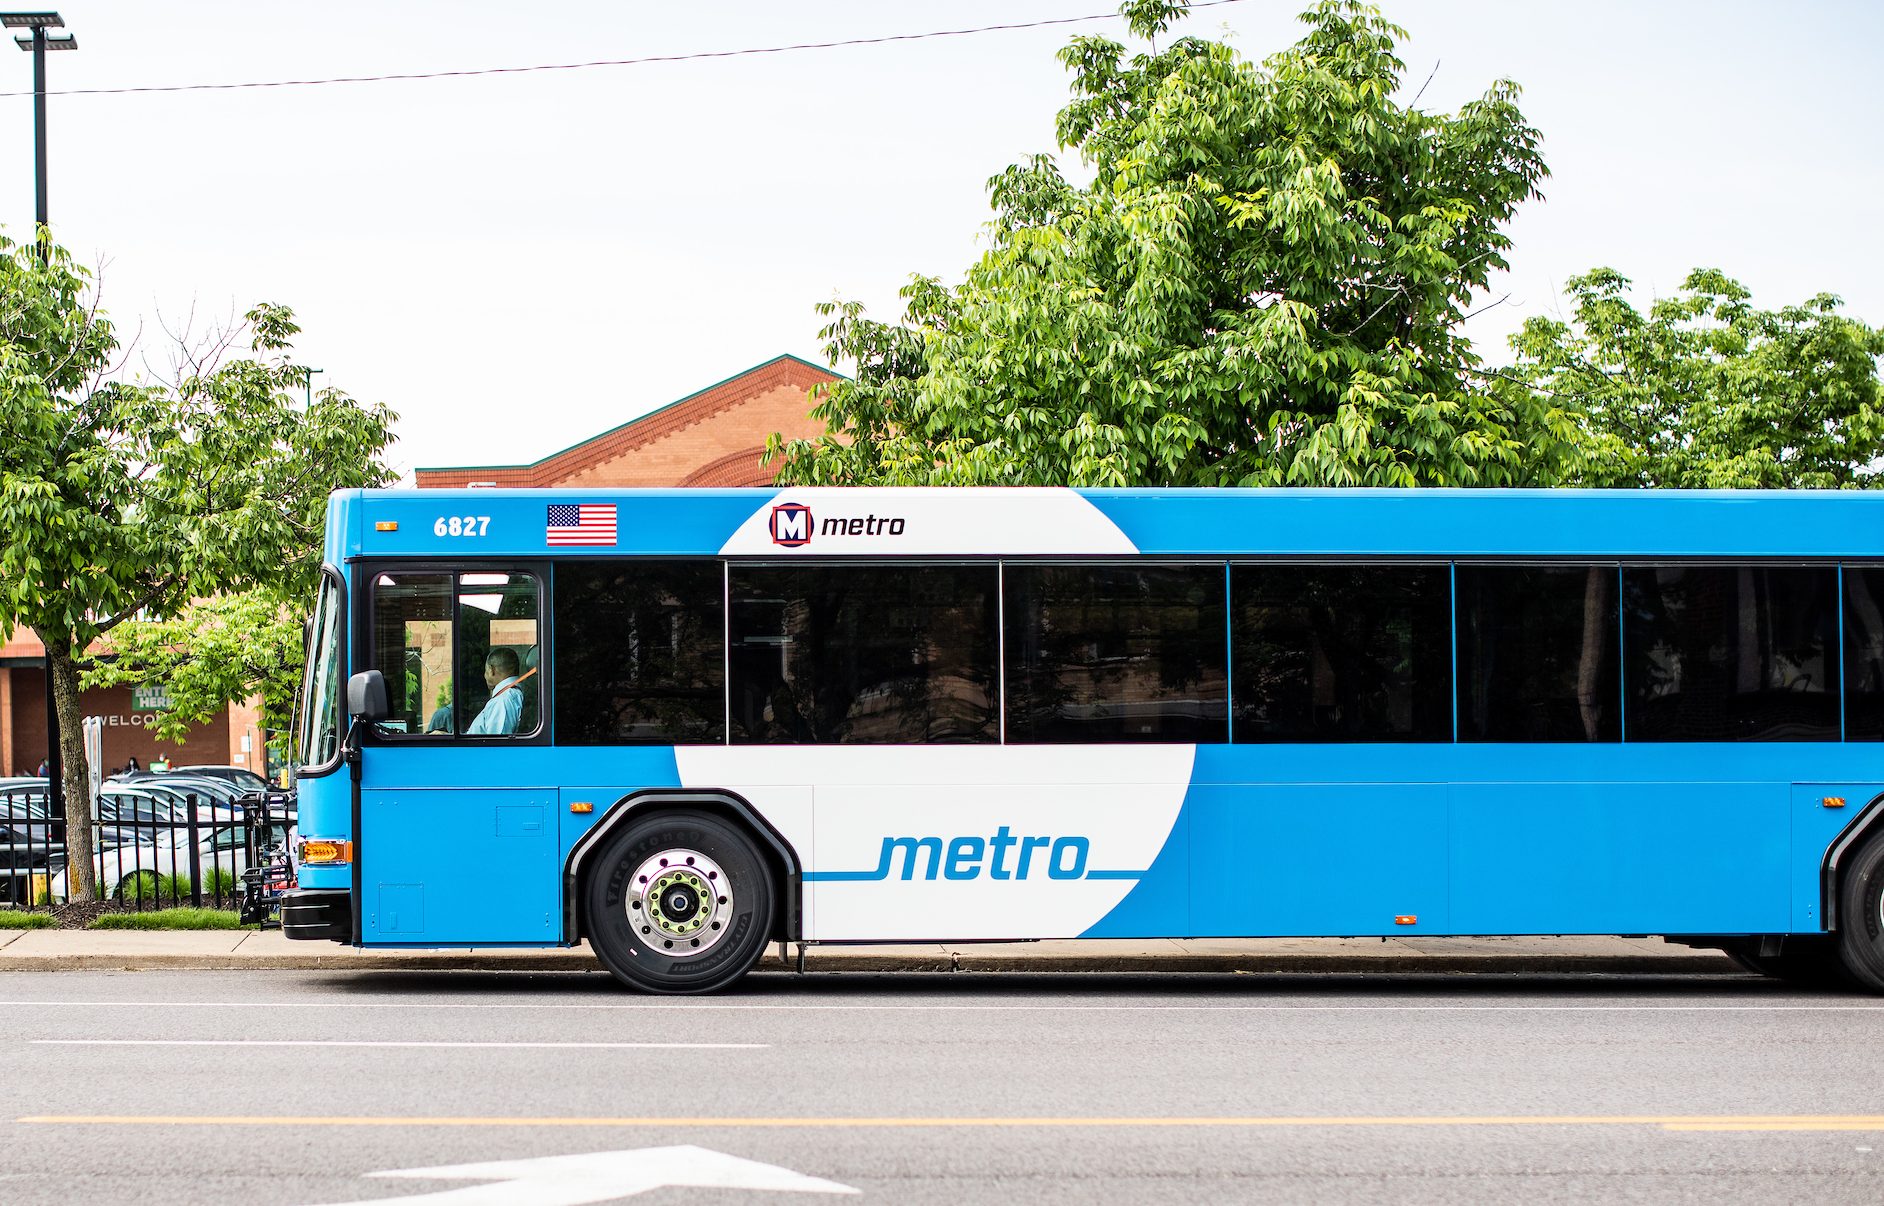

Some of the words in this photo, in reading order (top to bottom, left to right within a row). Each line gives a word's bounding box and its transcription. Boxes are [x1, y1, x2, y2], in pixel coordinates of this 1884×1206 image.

[433, 516, 491, 537] 6827
[821, 514, 905, 536] metro
[877, 826, 1090, 881] metro
